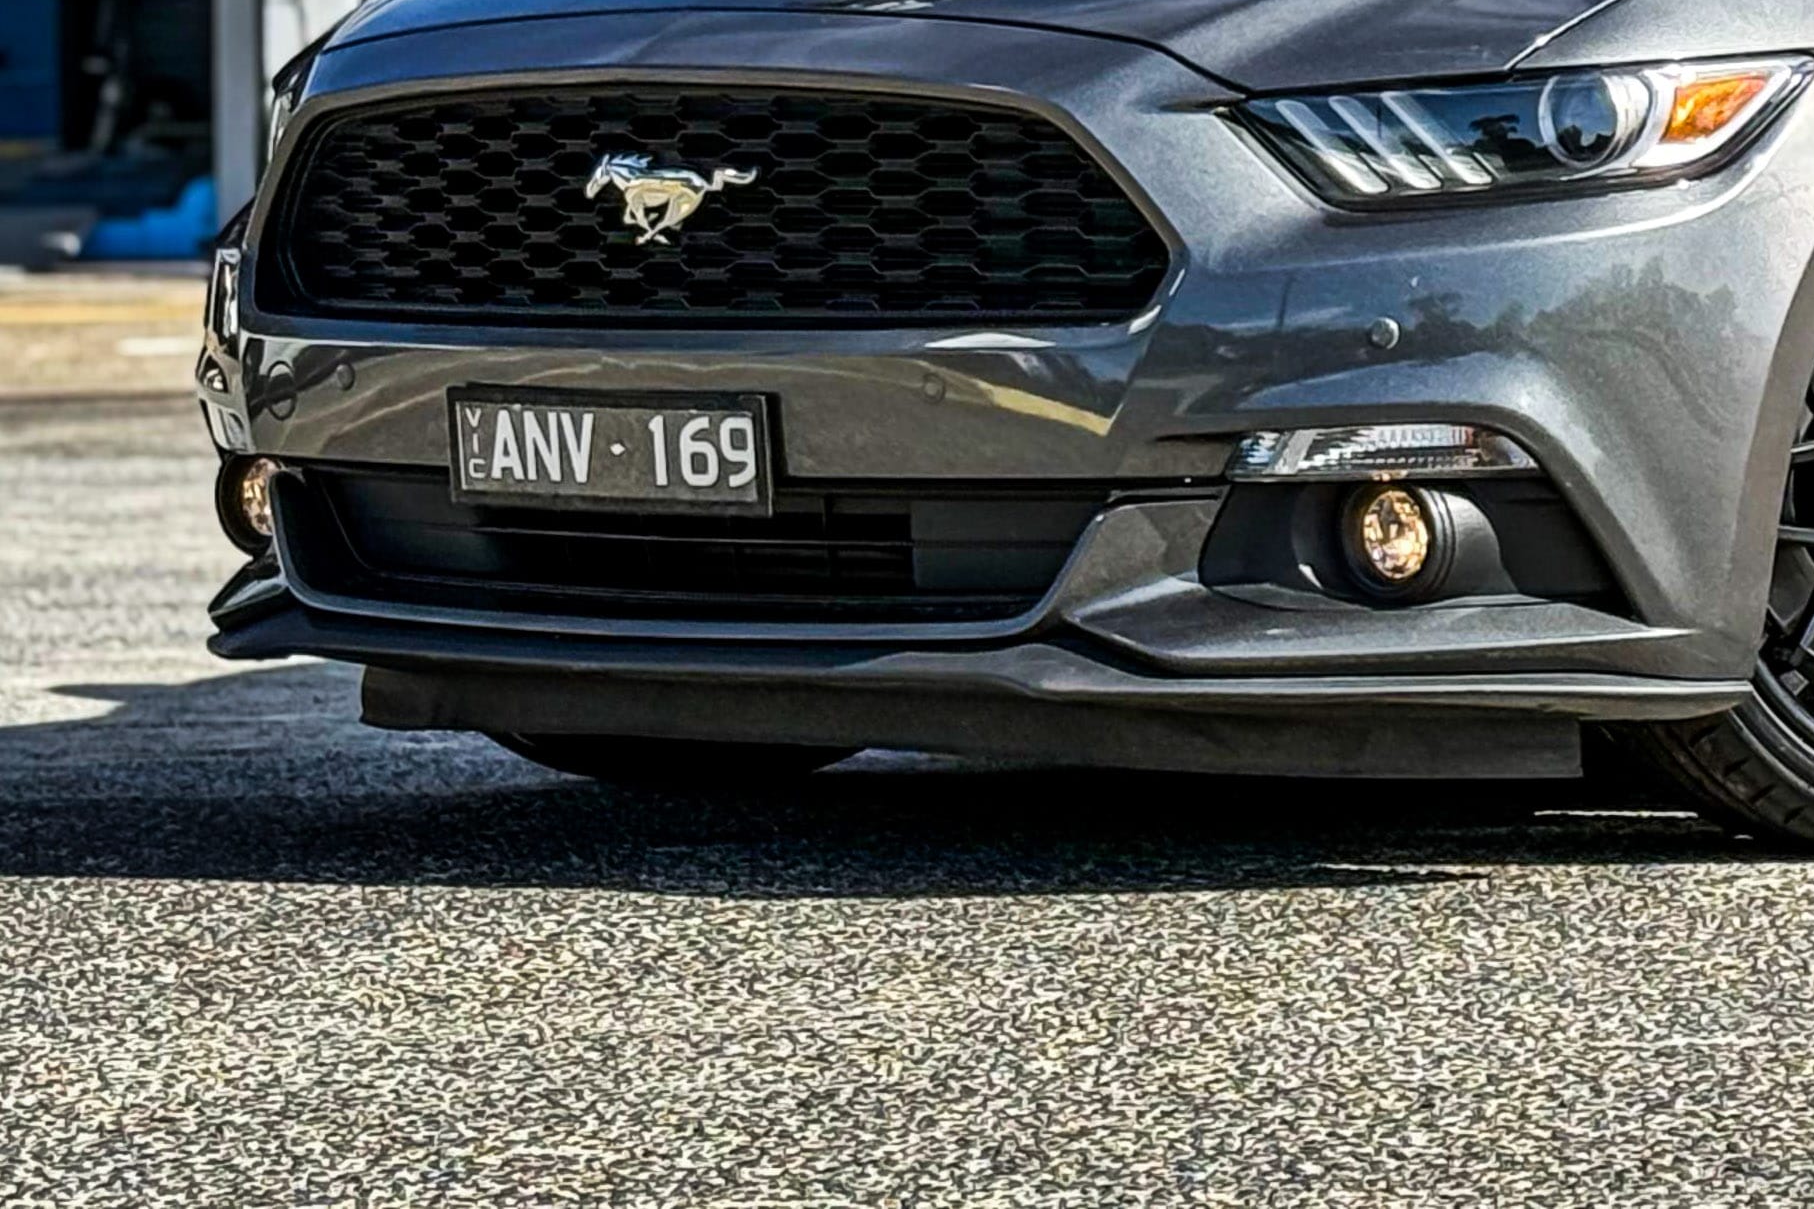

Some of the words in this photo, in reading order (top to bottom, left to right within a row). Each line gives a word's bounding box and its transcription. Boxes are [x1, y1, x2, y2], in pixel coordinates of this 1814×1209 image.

[464, 406, 486, 479] VIC
[491, 408, 595, 484] ANV
[648, 414, 757, 488] 169
